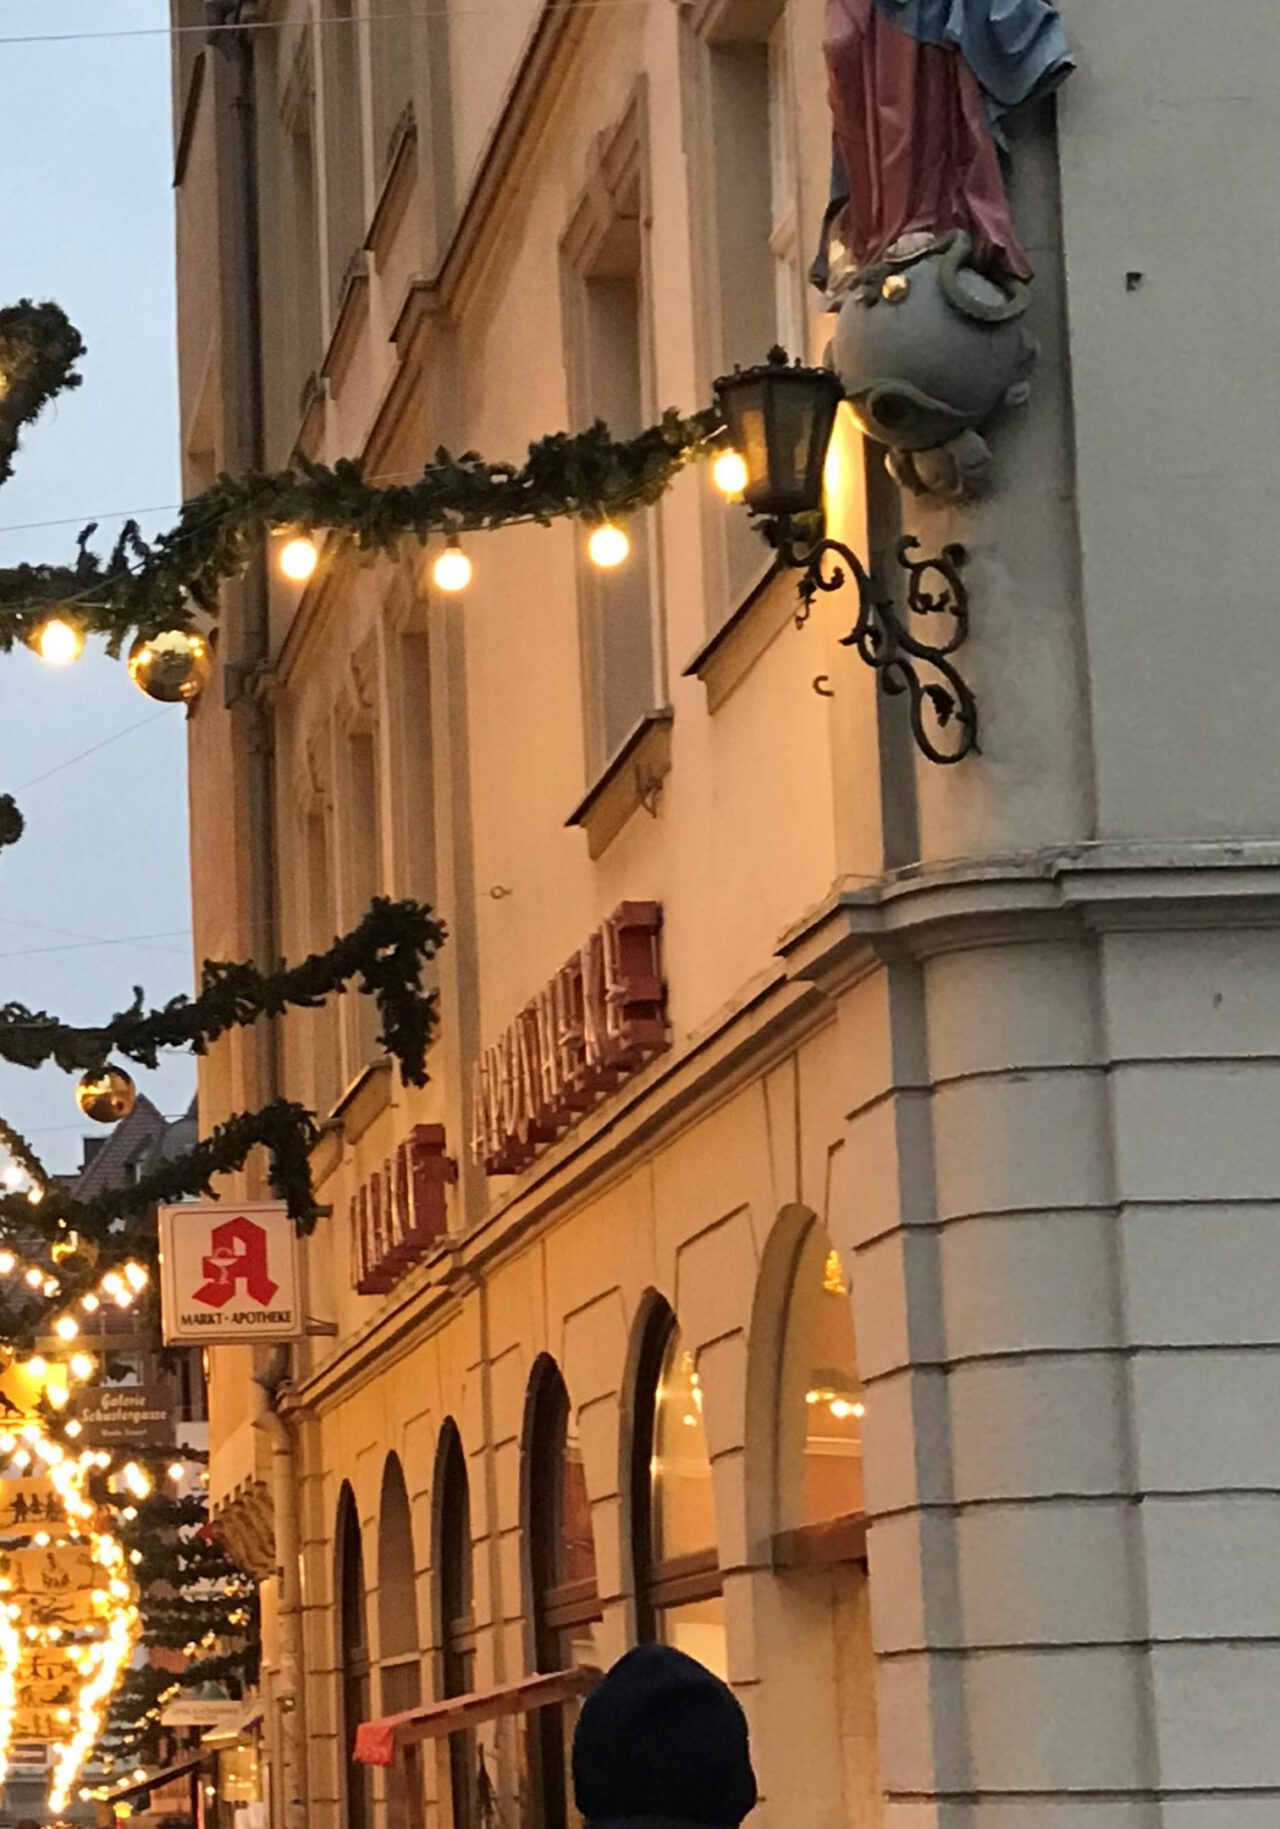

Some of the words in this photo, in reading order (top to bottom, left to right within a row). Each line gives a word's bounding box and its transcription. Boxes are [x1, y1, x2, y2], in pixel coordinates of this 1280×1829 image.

[180, 1313, 223, 1326] MARKT
[231, 1311, 293, 1325] APOTHEKE
[100, 1392, 147, 1410] Galerie
